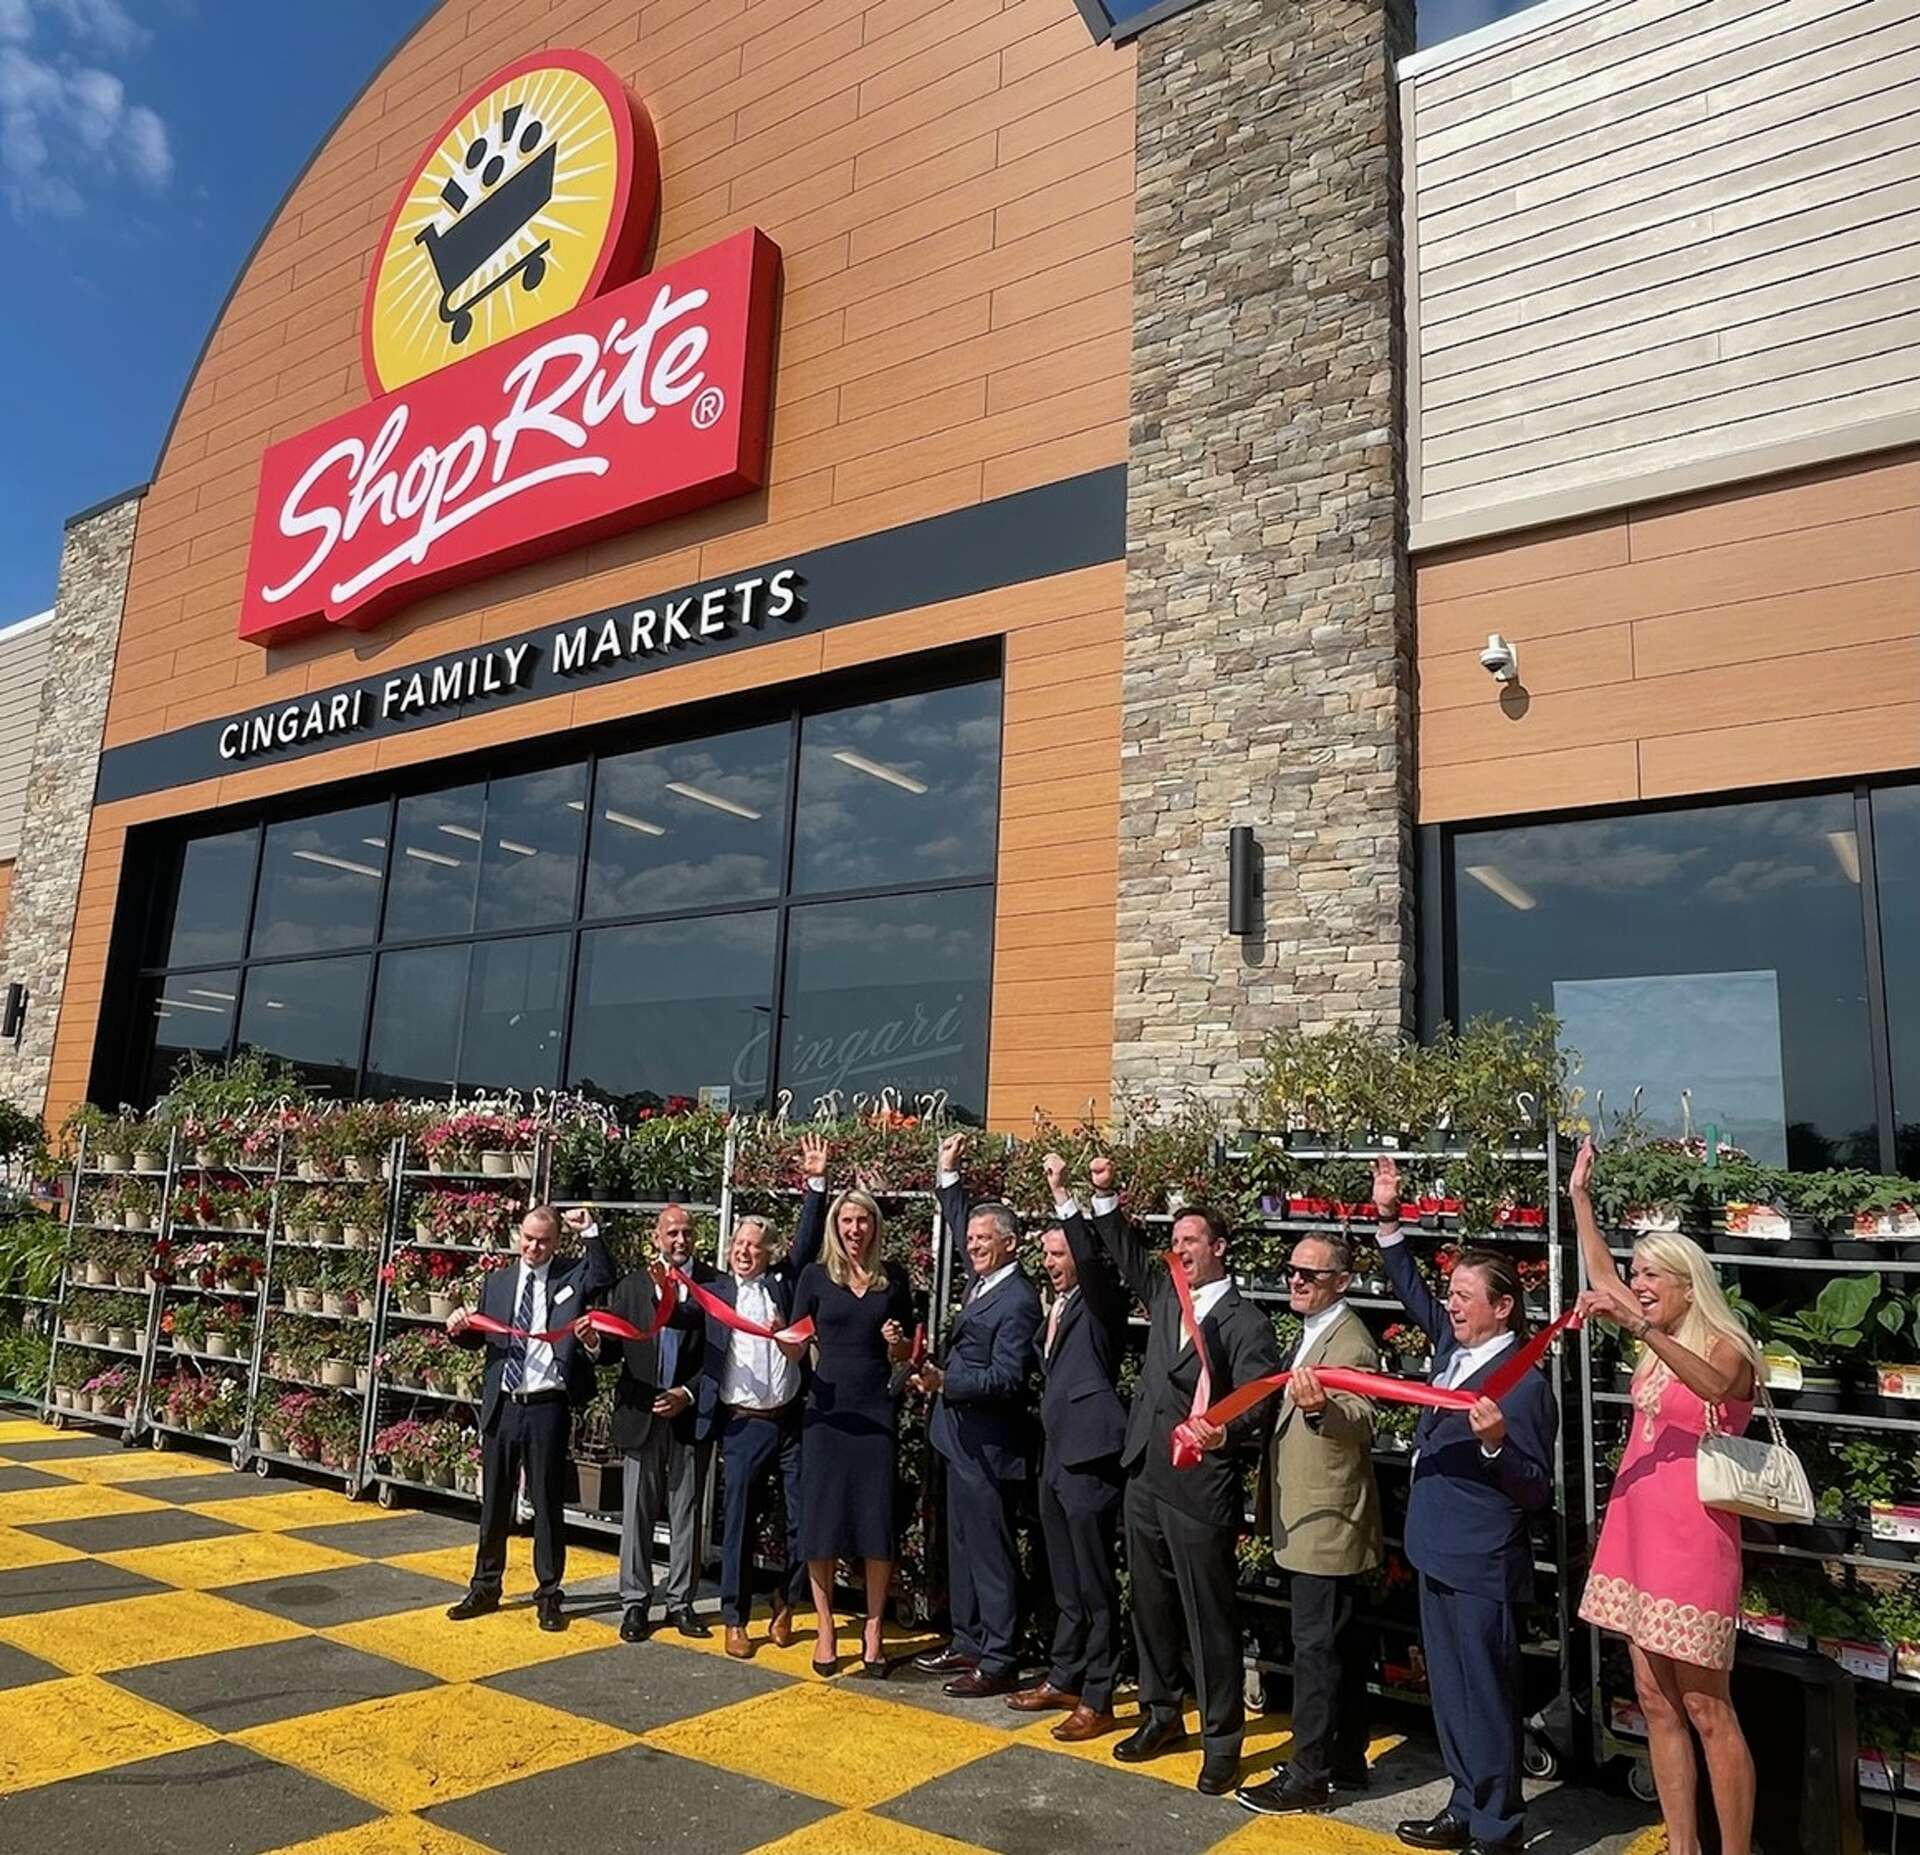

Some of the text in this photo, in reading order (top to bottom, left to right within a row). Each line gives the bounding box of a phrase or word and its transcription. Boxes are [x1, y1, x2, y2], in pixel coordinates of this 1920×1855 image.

[261, 284, 710, 603] ShopRite
[218, 569, 796, 760] CINGARI FAMILY MARKETS
